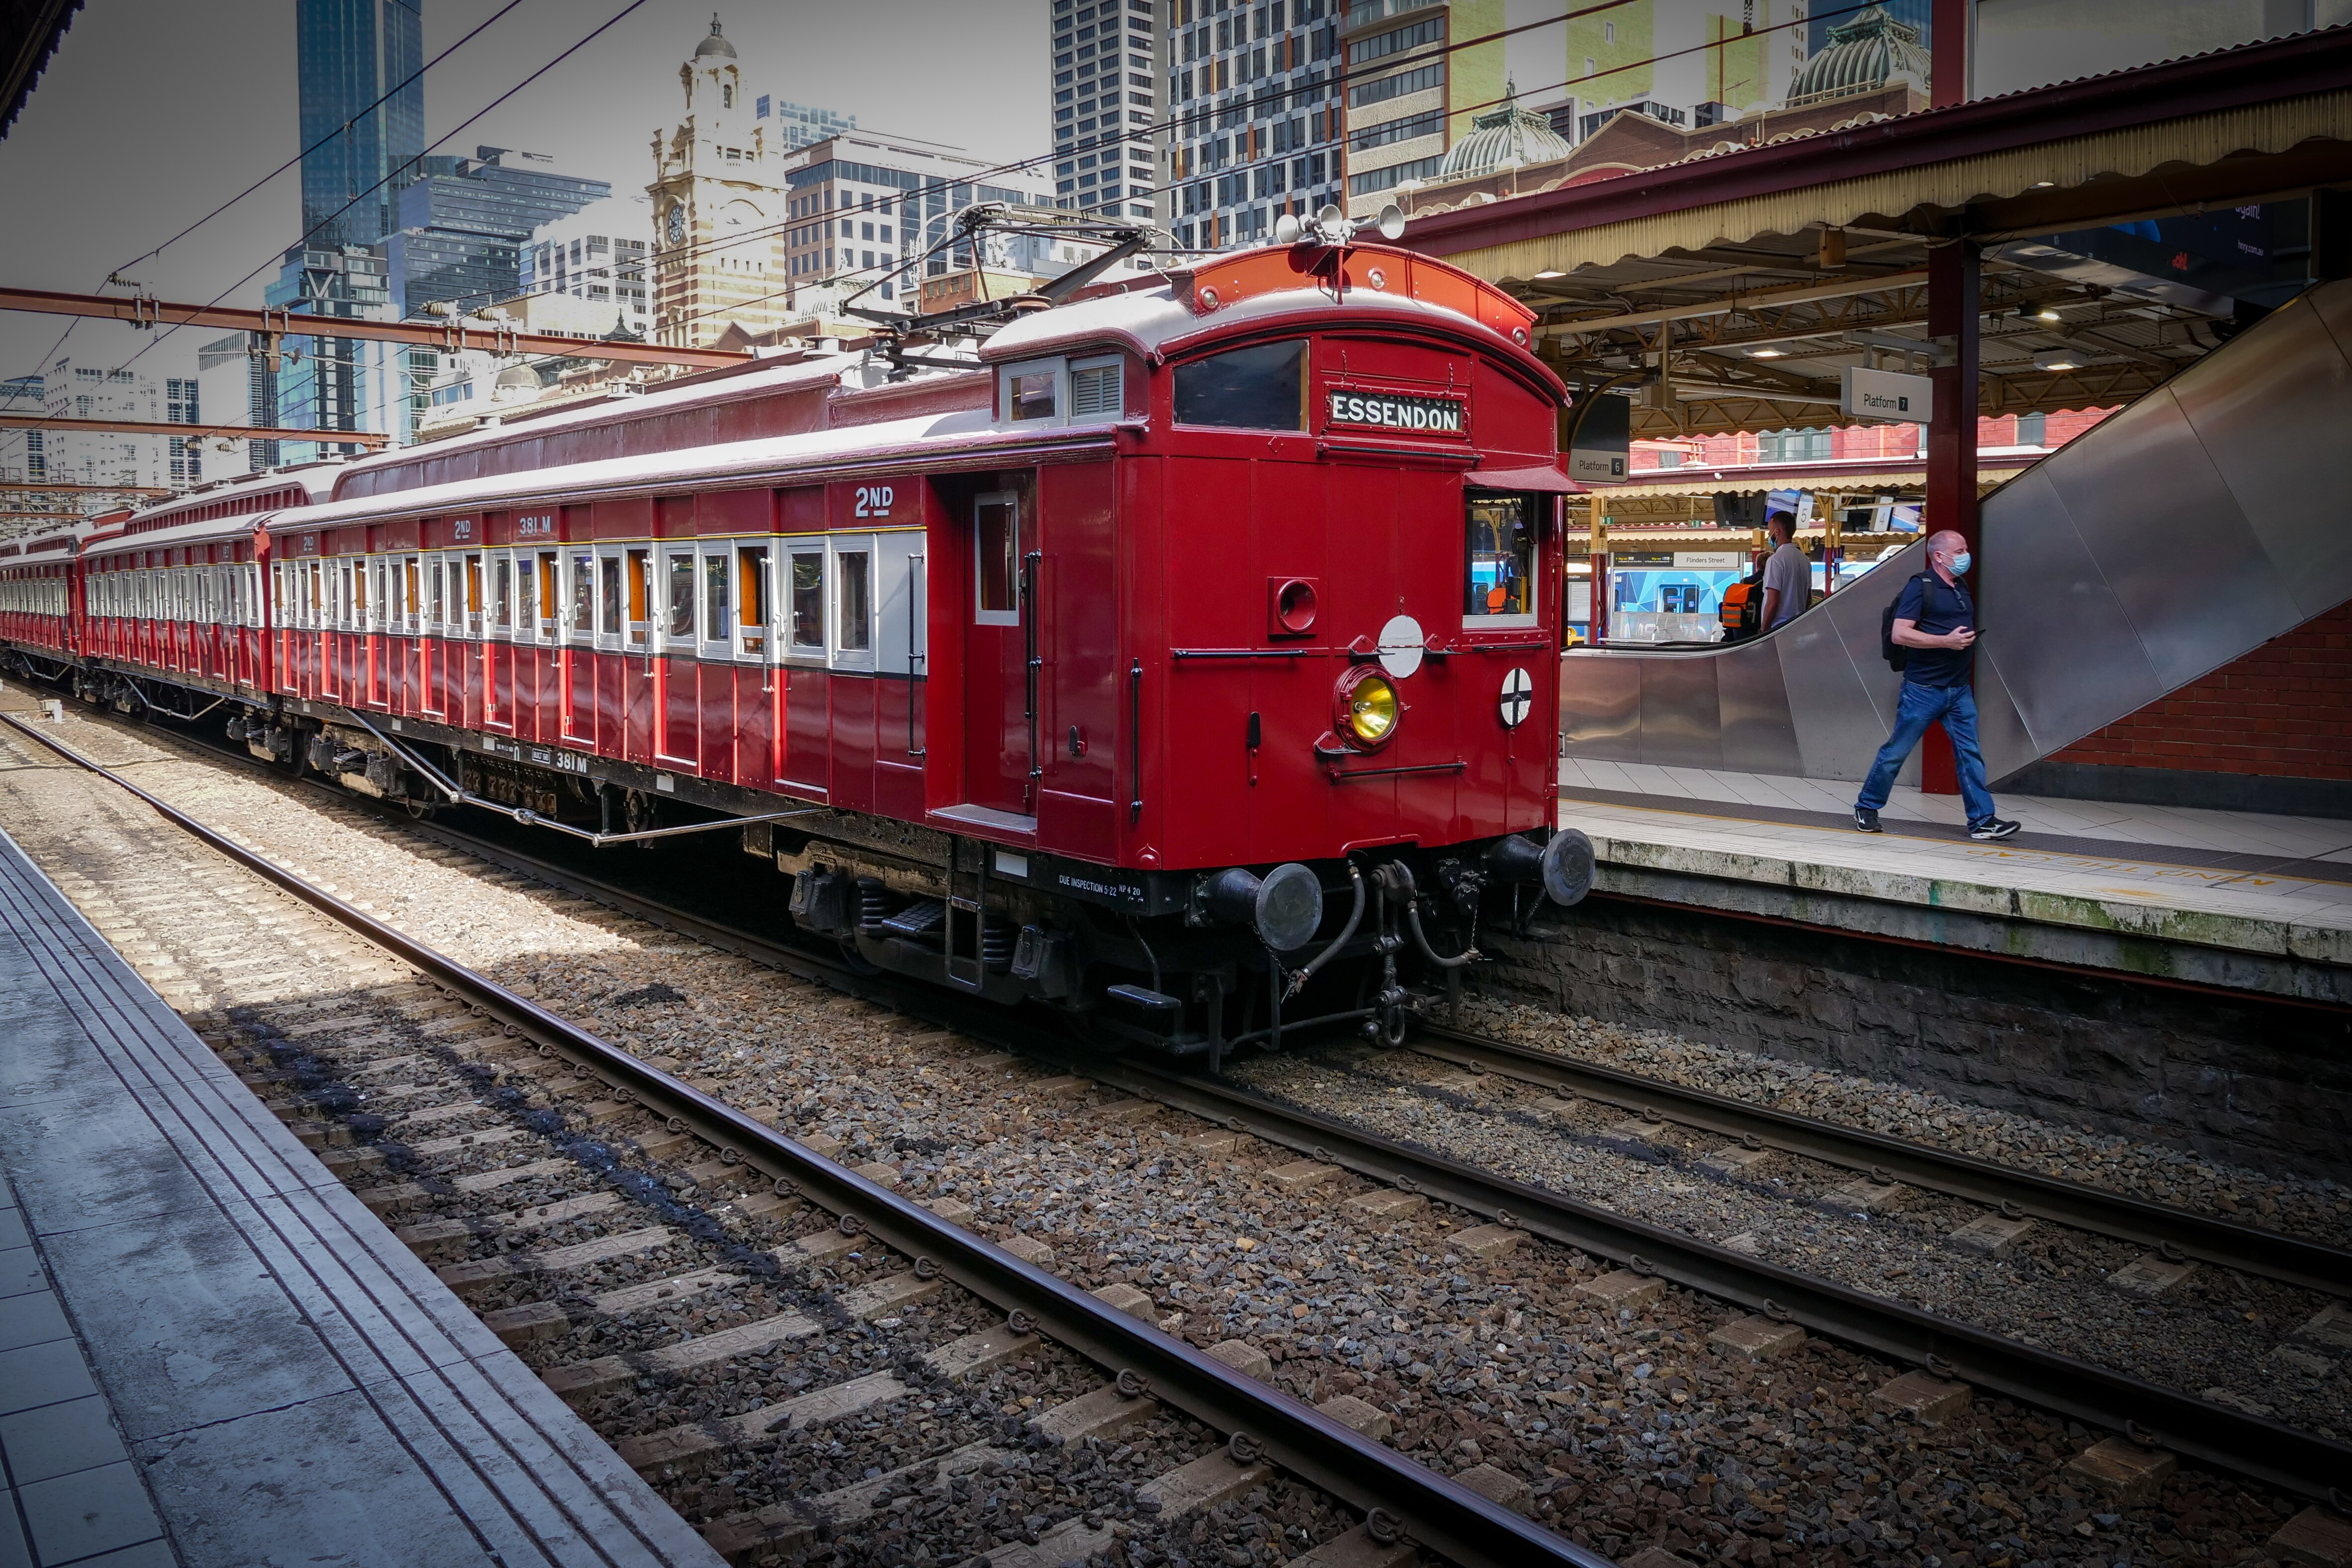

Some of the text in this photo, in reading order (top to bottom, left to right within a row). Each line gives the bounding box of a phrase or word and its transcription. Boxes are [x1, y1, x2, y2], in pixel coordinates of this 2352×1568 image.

[2238, 240, 2264, 257] hnry.com.au
[1864, 393, 1906, 409] Platform 7
[1332, 396, 1457, 430] ESSENDON
[1579, 460, 1620, 472] Platform 6
[856, 487, 893, 517] 2ND
[1801, 508, 1808, 523] 5
[1879, 511, 1885, 526] 4
[454, 520, 470, 540] 2ND
[520, 516, 551, 535] 381 M
[303, 536, 314, 551] 2ND
[533, 751, 542, 760] BUILT
[556, 752, 587, 773] 381 M
[1966, 850, 2276, 887] MIND THE GAP
[1059, 874, 1070, 885] DUE
[1071, 877, 1103, 893] INSPECTION
[1127, 885, 1131, 894] 4
[1132, 887, 1140, 896] 20
